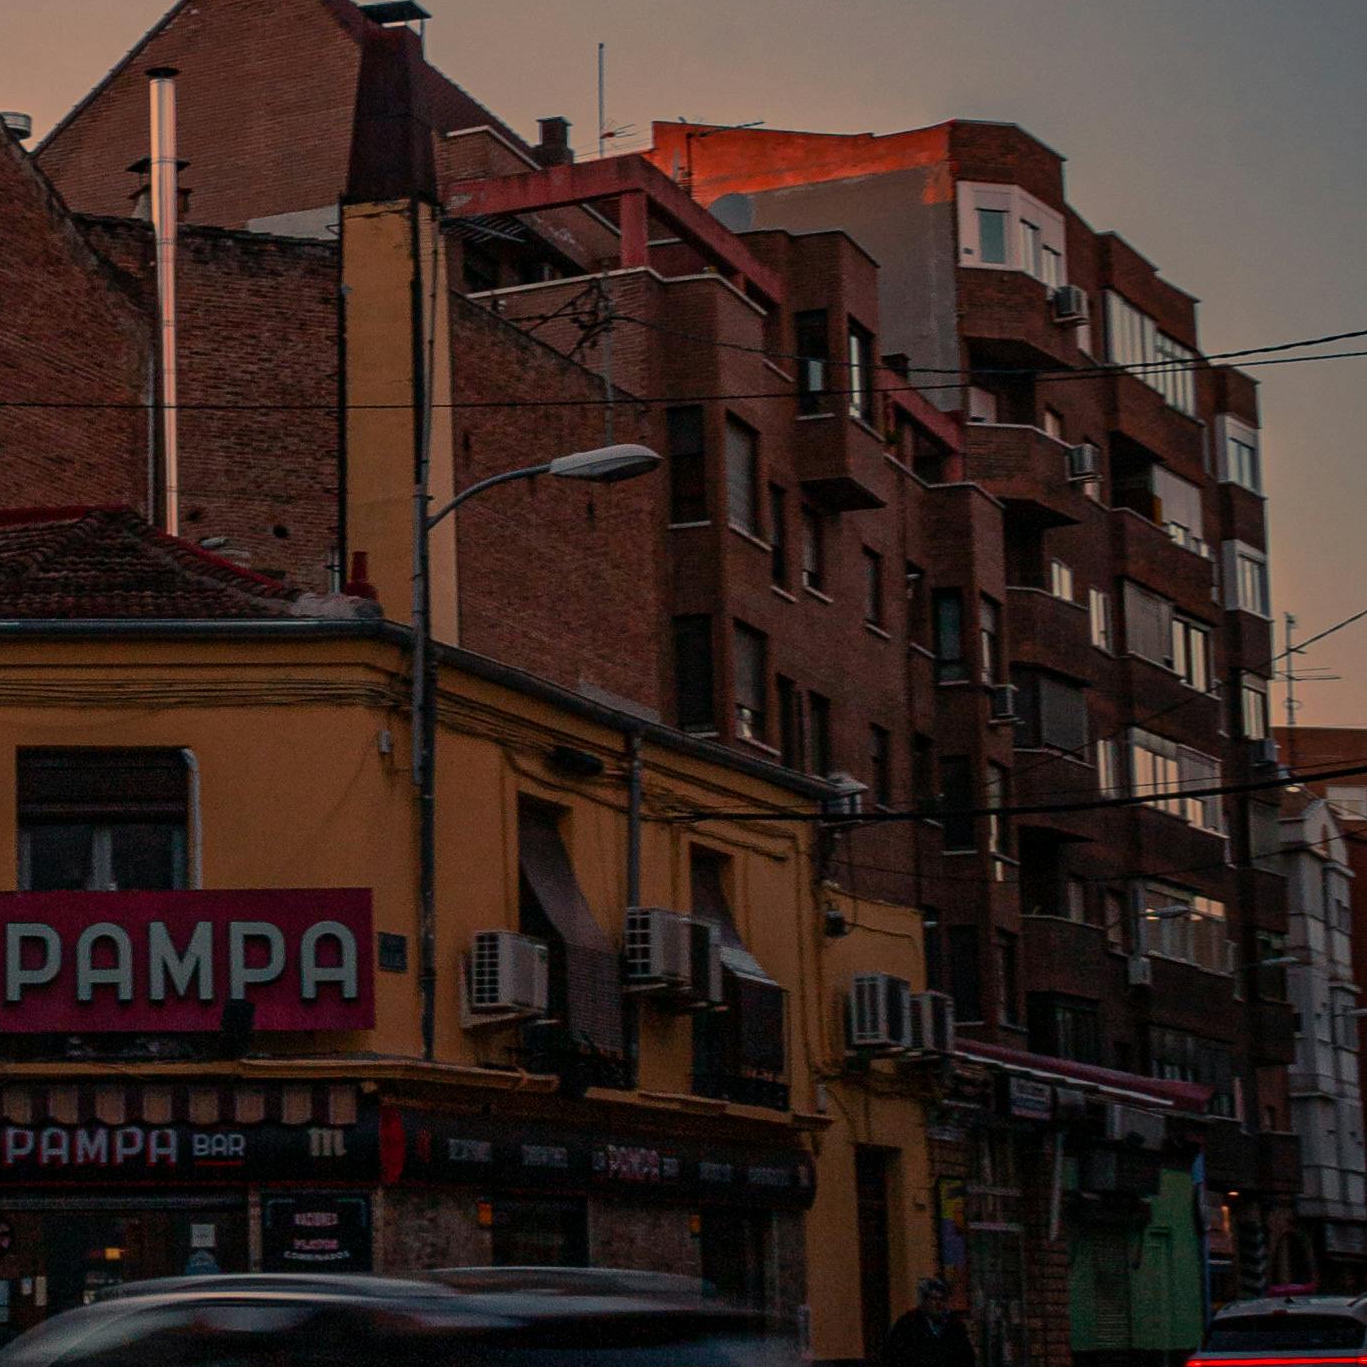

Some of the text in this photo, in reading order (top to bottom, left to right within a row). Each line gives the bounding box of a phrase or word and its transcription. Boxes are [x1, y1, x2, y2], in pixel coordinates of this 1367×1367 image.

[4, 920, 359, 1004] PAMPA
[2, 1127, 179, 1166] PAMPA
[191, 1134, 246, 1158] BAR
